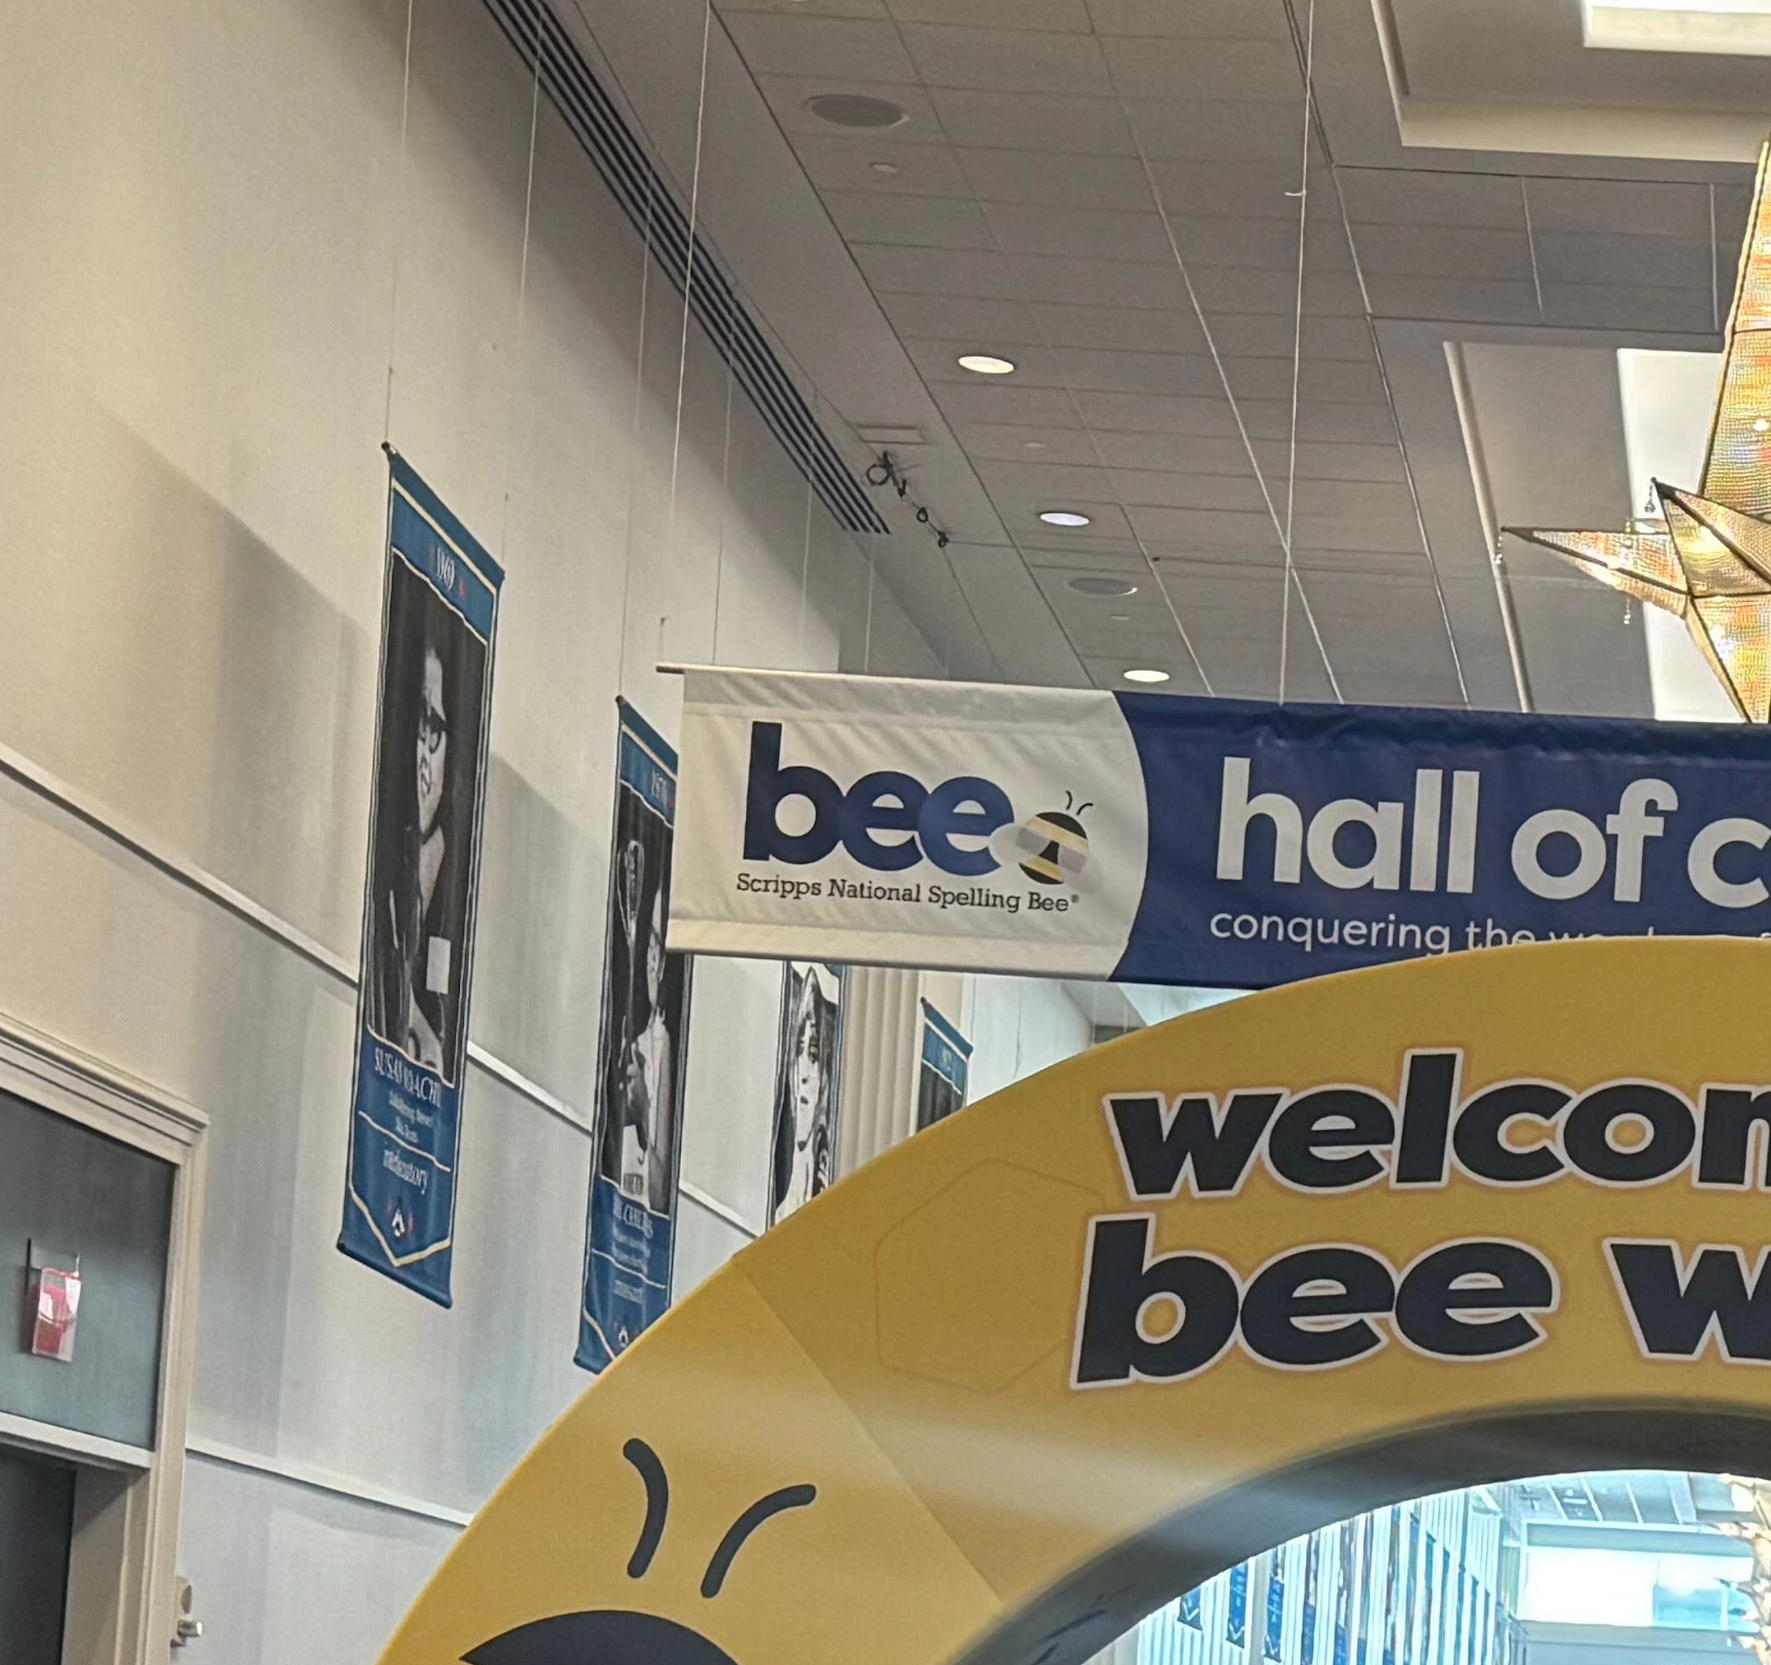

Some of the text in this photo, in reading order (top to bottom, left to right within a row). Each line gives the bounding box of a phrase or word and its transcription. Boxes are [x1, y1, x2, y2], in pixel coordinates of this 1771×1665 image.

[743, 721, 1015, 877] bee
[1216, 756, 1480, 894] hall
[1511, 778, 1679, 902] of
[736, 872, 822, 899] Scripps
[827, 878, 921, 904] National
[927, 885, 1020, 912] Spelling
[1210, 911, 1451, 953] conquering
[1466, 918, 1535, 950] the
[1070, 1214, 1561, 1390] bee
